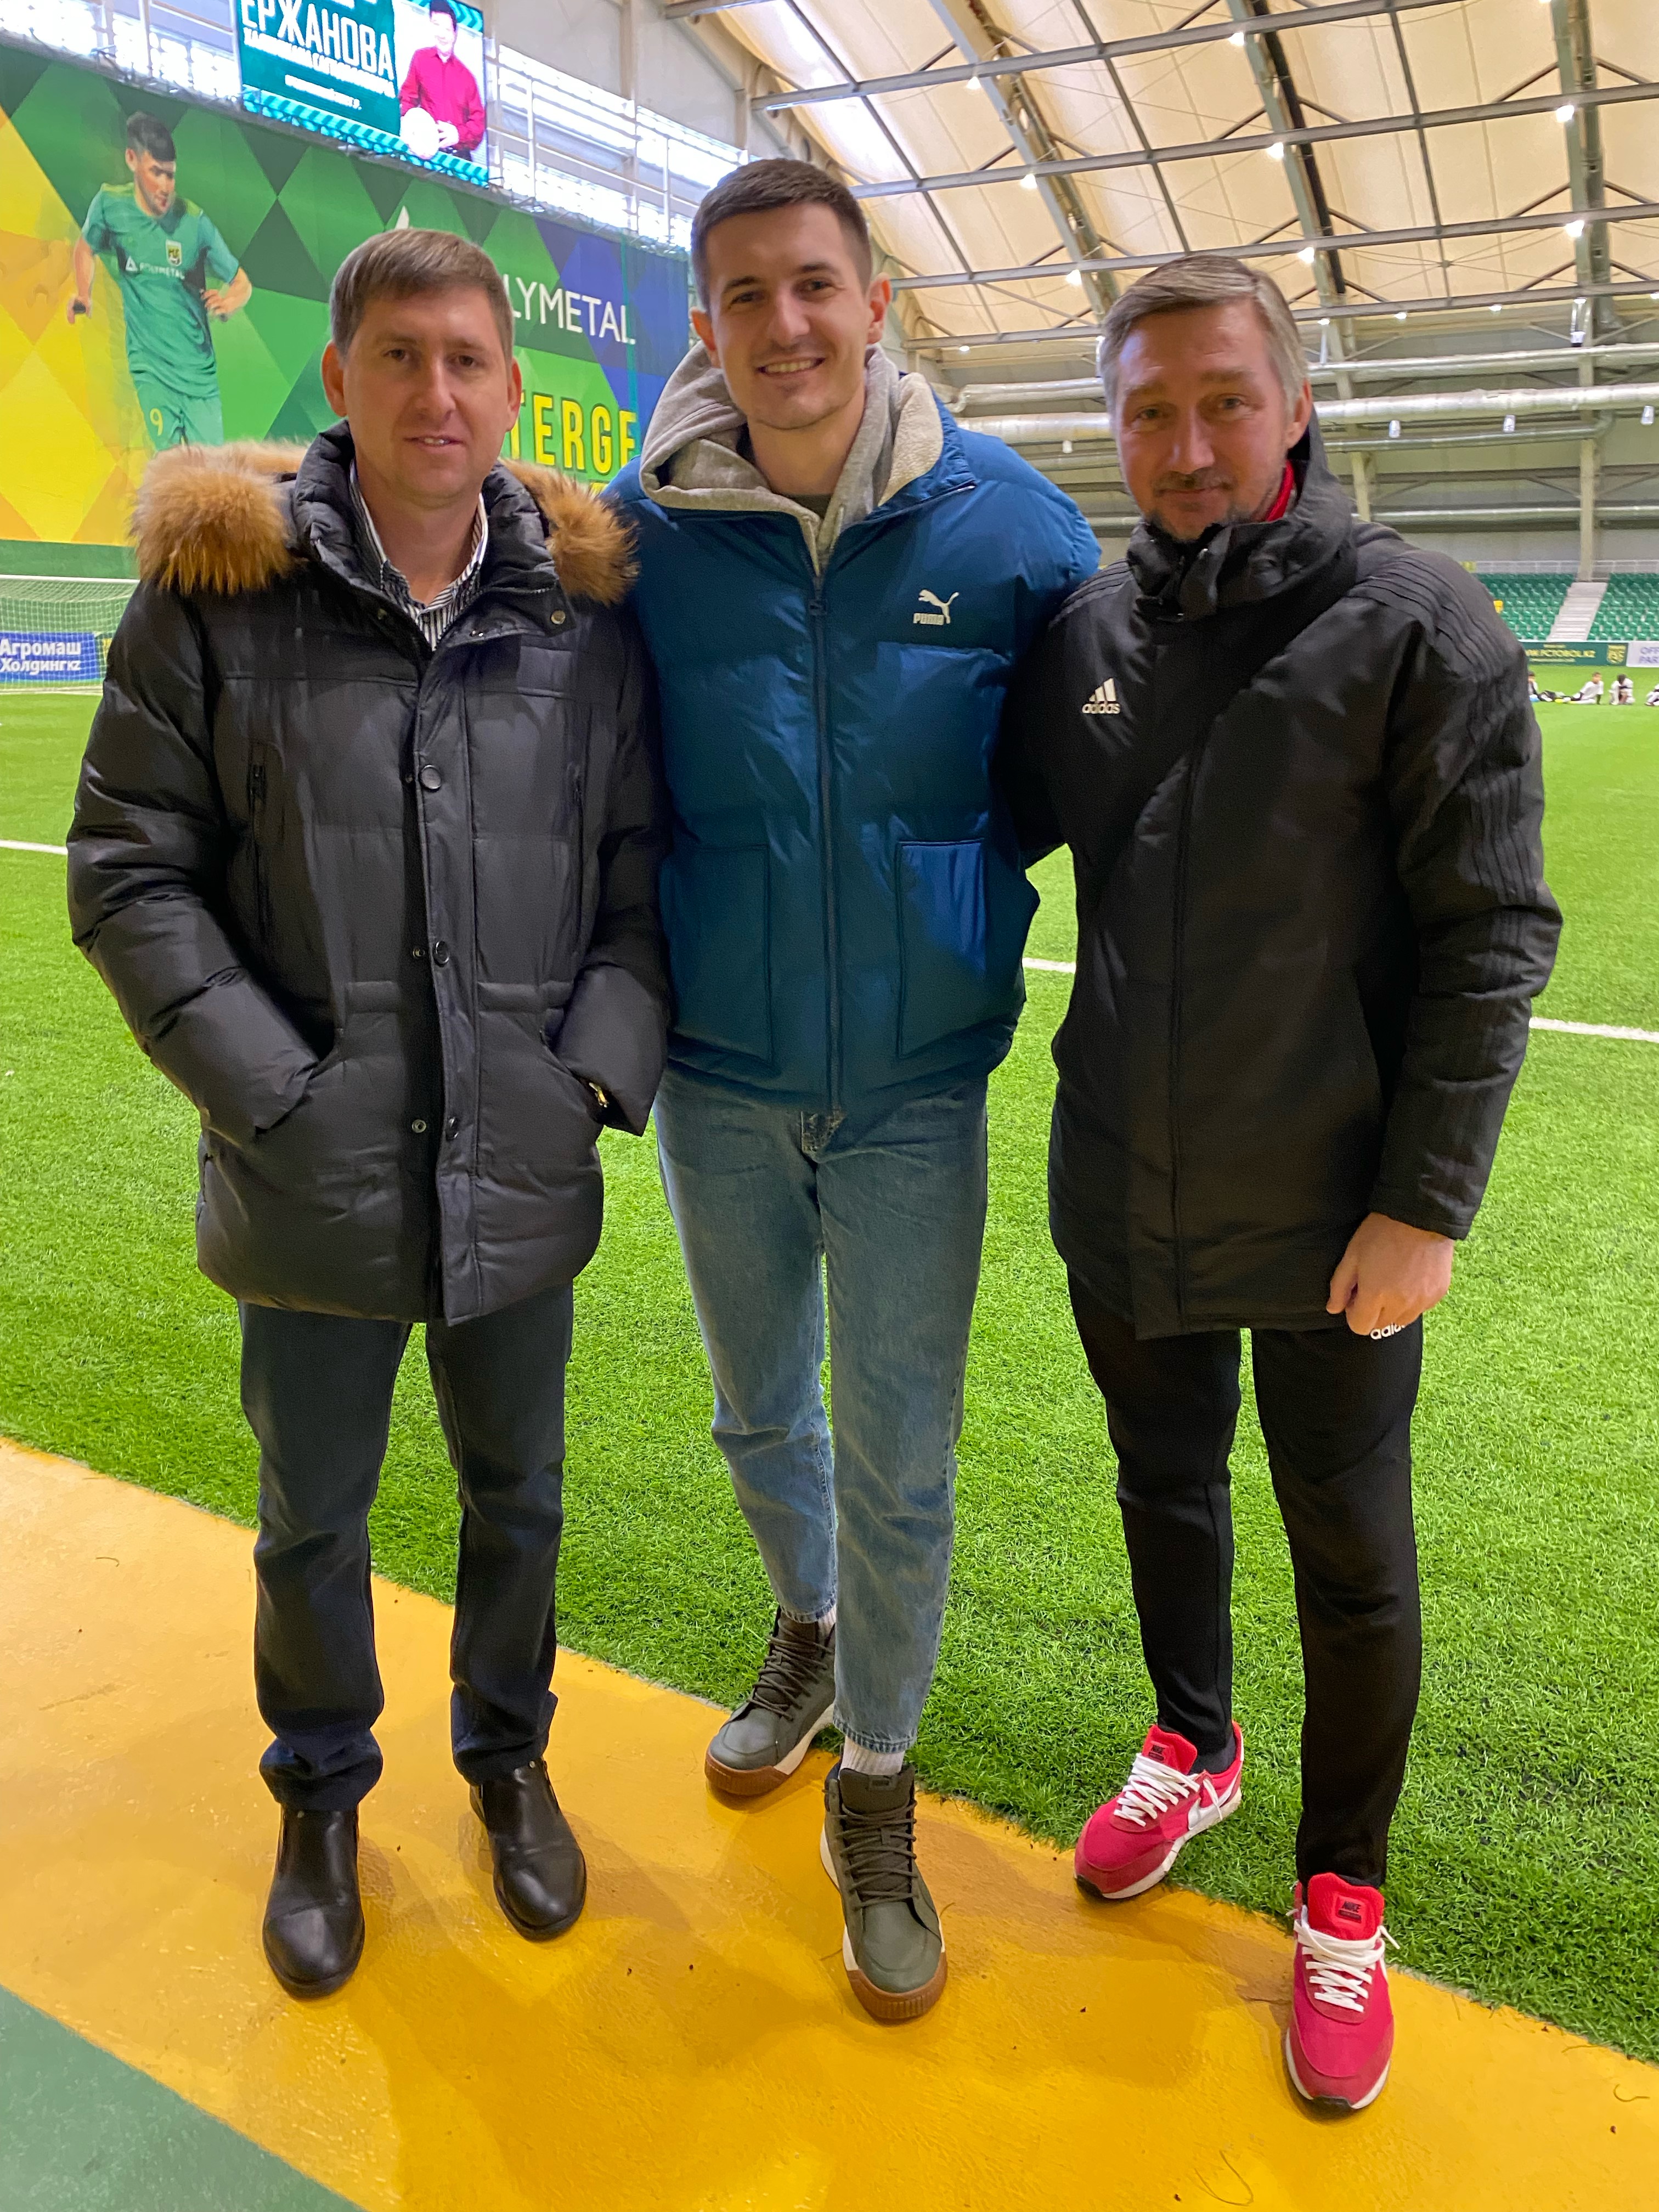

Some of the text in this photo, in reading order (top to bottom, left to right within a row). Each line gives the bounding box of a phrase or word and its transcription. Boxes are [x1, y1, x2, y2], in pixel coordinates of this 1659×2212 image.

[241, 0, 395, 81] ЕРЖАНОВА
[149, 408, 163, 436] 9
[913, 613, 945, 625] PUMA
[0, 638, 82, 659] Агромаш
[1082, 703, 1120, 714] adidas
